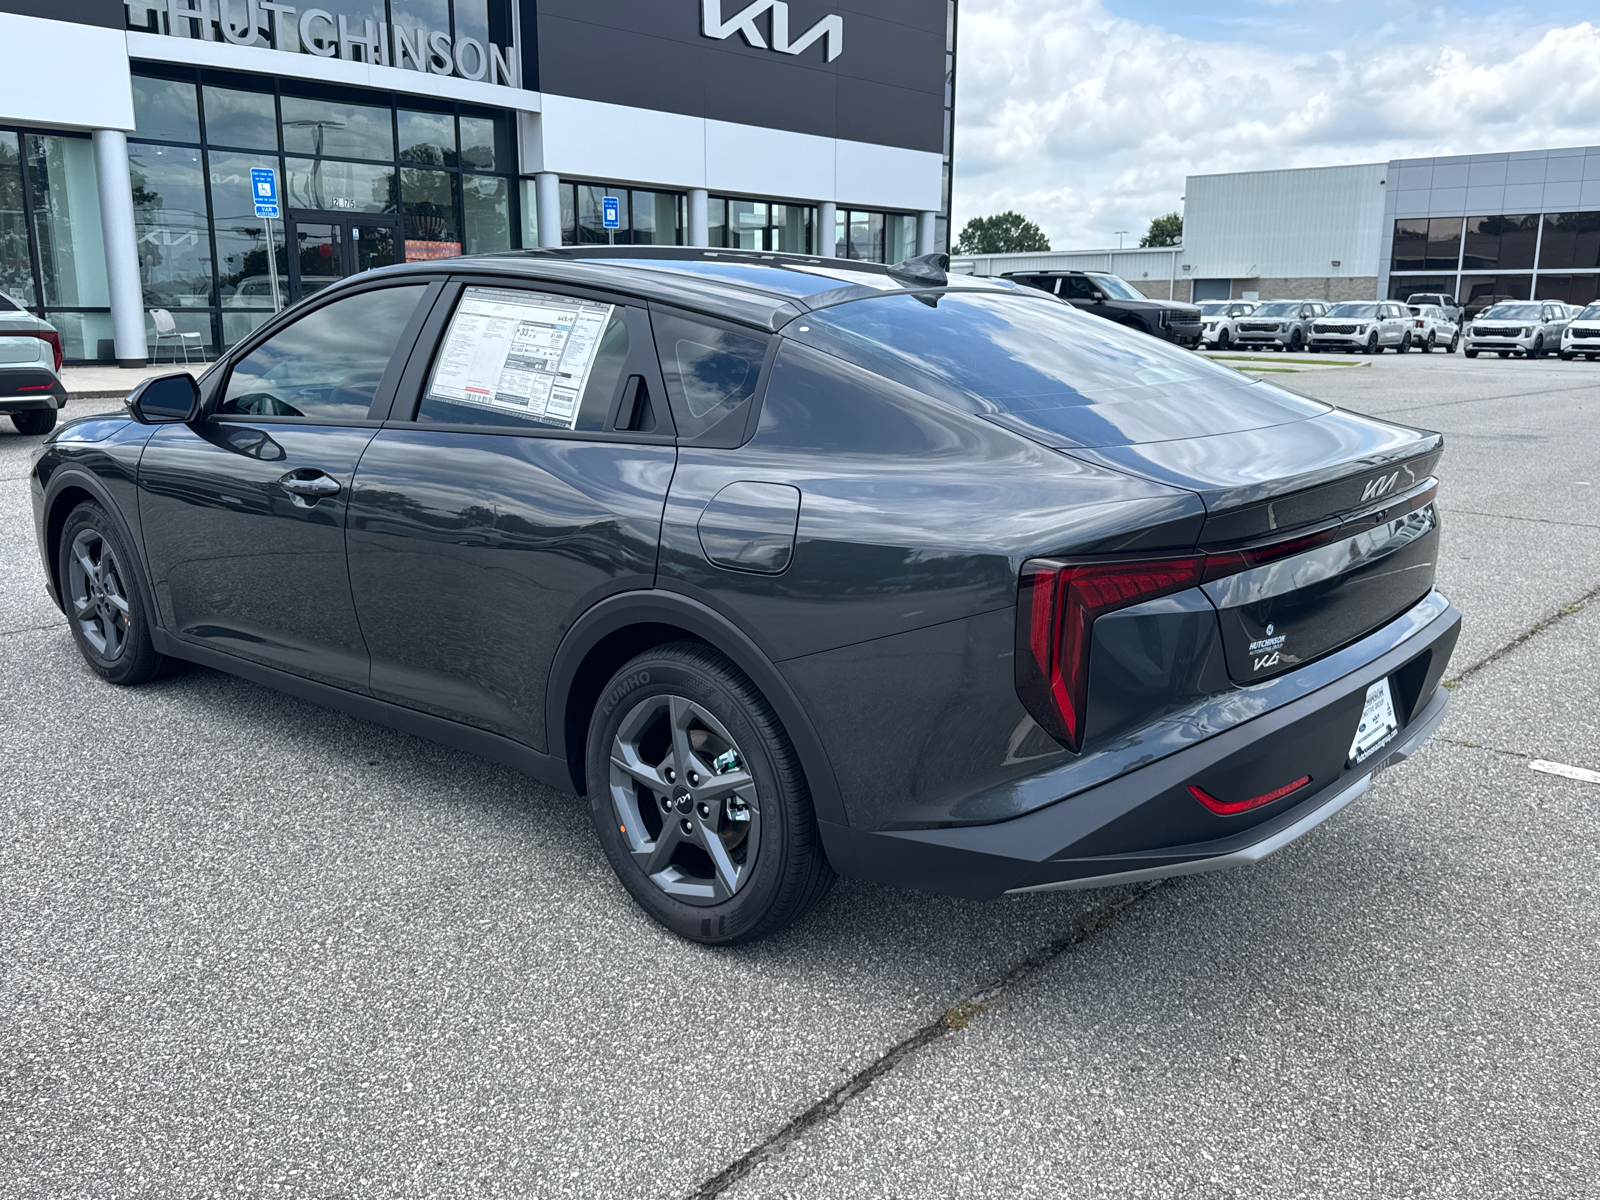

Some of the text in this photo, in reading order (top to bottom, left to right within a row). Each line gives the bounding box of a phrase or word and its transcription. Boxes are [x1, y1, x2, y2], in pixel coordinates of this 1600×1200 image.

[168, 0, 524, 89] HUTCHINSON
[703, 0, 843, 63] KIA
[519, 328, 530, 337] 33
[1361, 471, 1399, 501] KIA
[1249, 635, 1287, 651] HUTCHINSON
[602, 671, 651, 716] KUMHO
